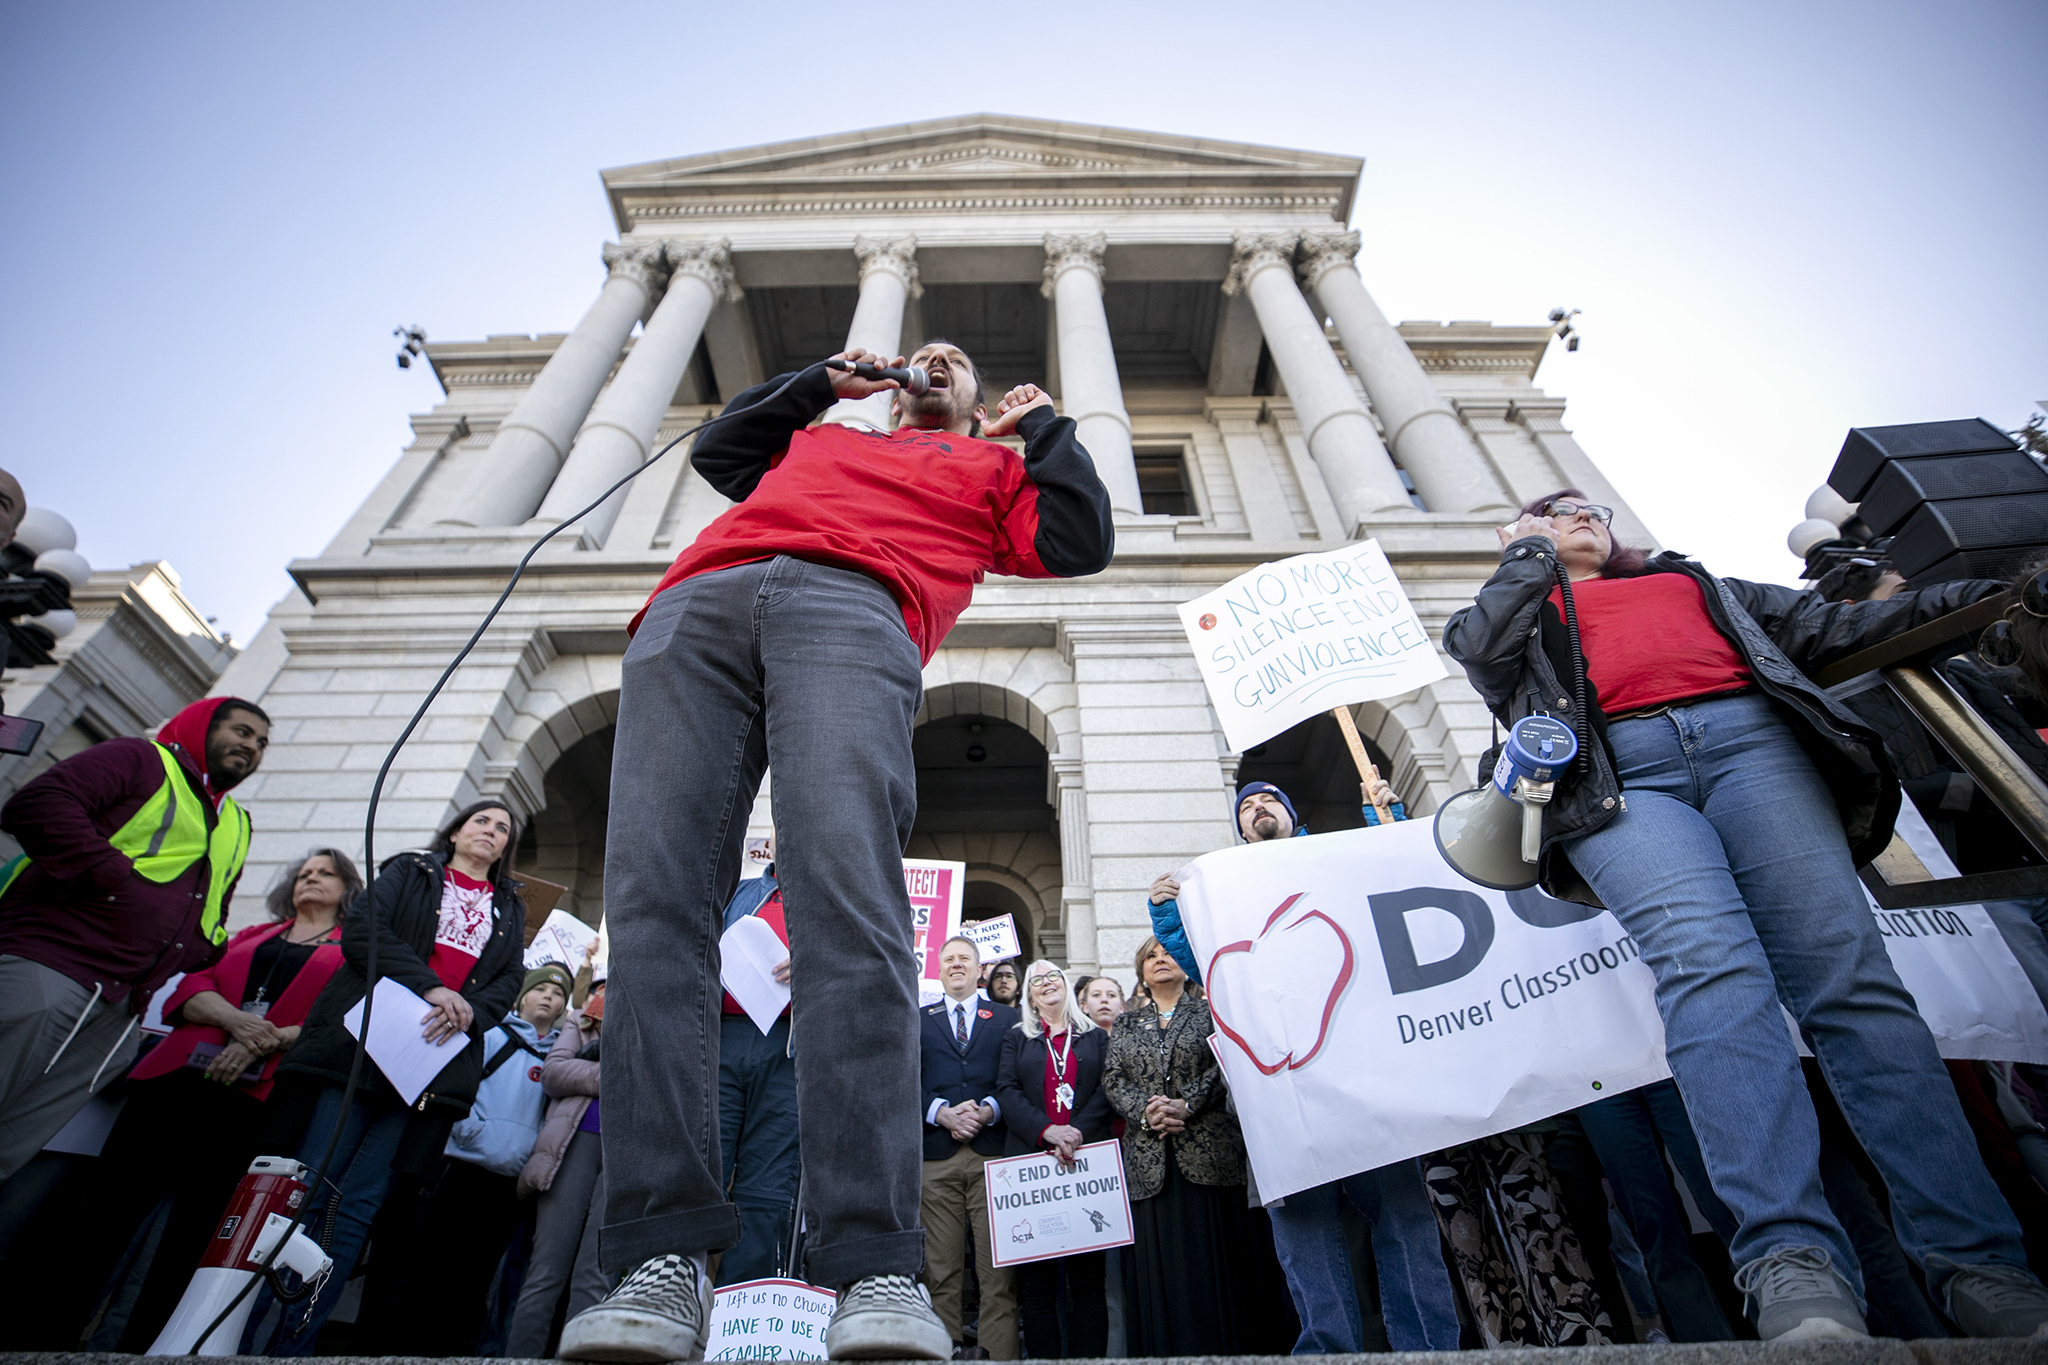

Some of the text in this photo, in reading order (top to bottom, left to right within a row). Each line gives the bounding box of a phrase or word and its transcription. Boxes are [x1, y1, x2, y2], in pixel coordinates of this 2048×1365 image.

[1226, 551, 1388, 628] NO MORE
[1212, 590, 1399, 674] SILENCE END
[1234, 615, 1429, 708] GUN VIOLENCE!
[1397, 1000, 1494, 1045] Denver
[1018, 1164, 1050, 1183] END
[993, 1176, 1121, 1211] VIOLENCE NOW!
[1012, 1232, 1035, 1243] DCTA
[727, 1291, 748, 1308] left
[752, 1292, 767, 1305] us
[772, 1293, 788, 1307] no
[722, 1317, 760, 1337] HAVE
[766, 1317, 784, 1332] TO
[791, 1320, 814, 1338] USE
